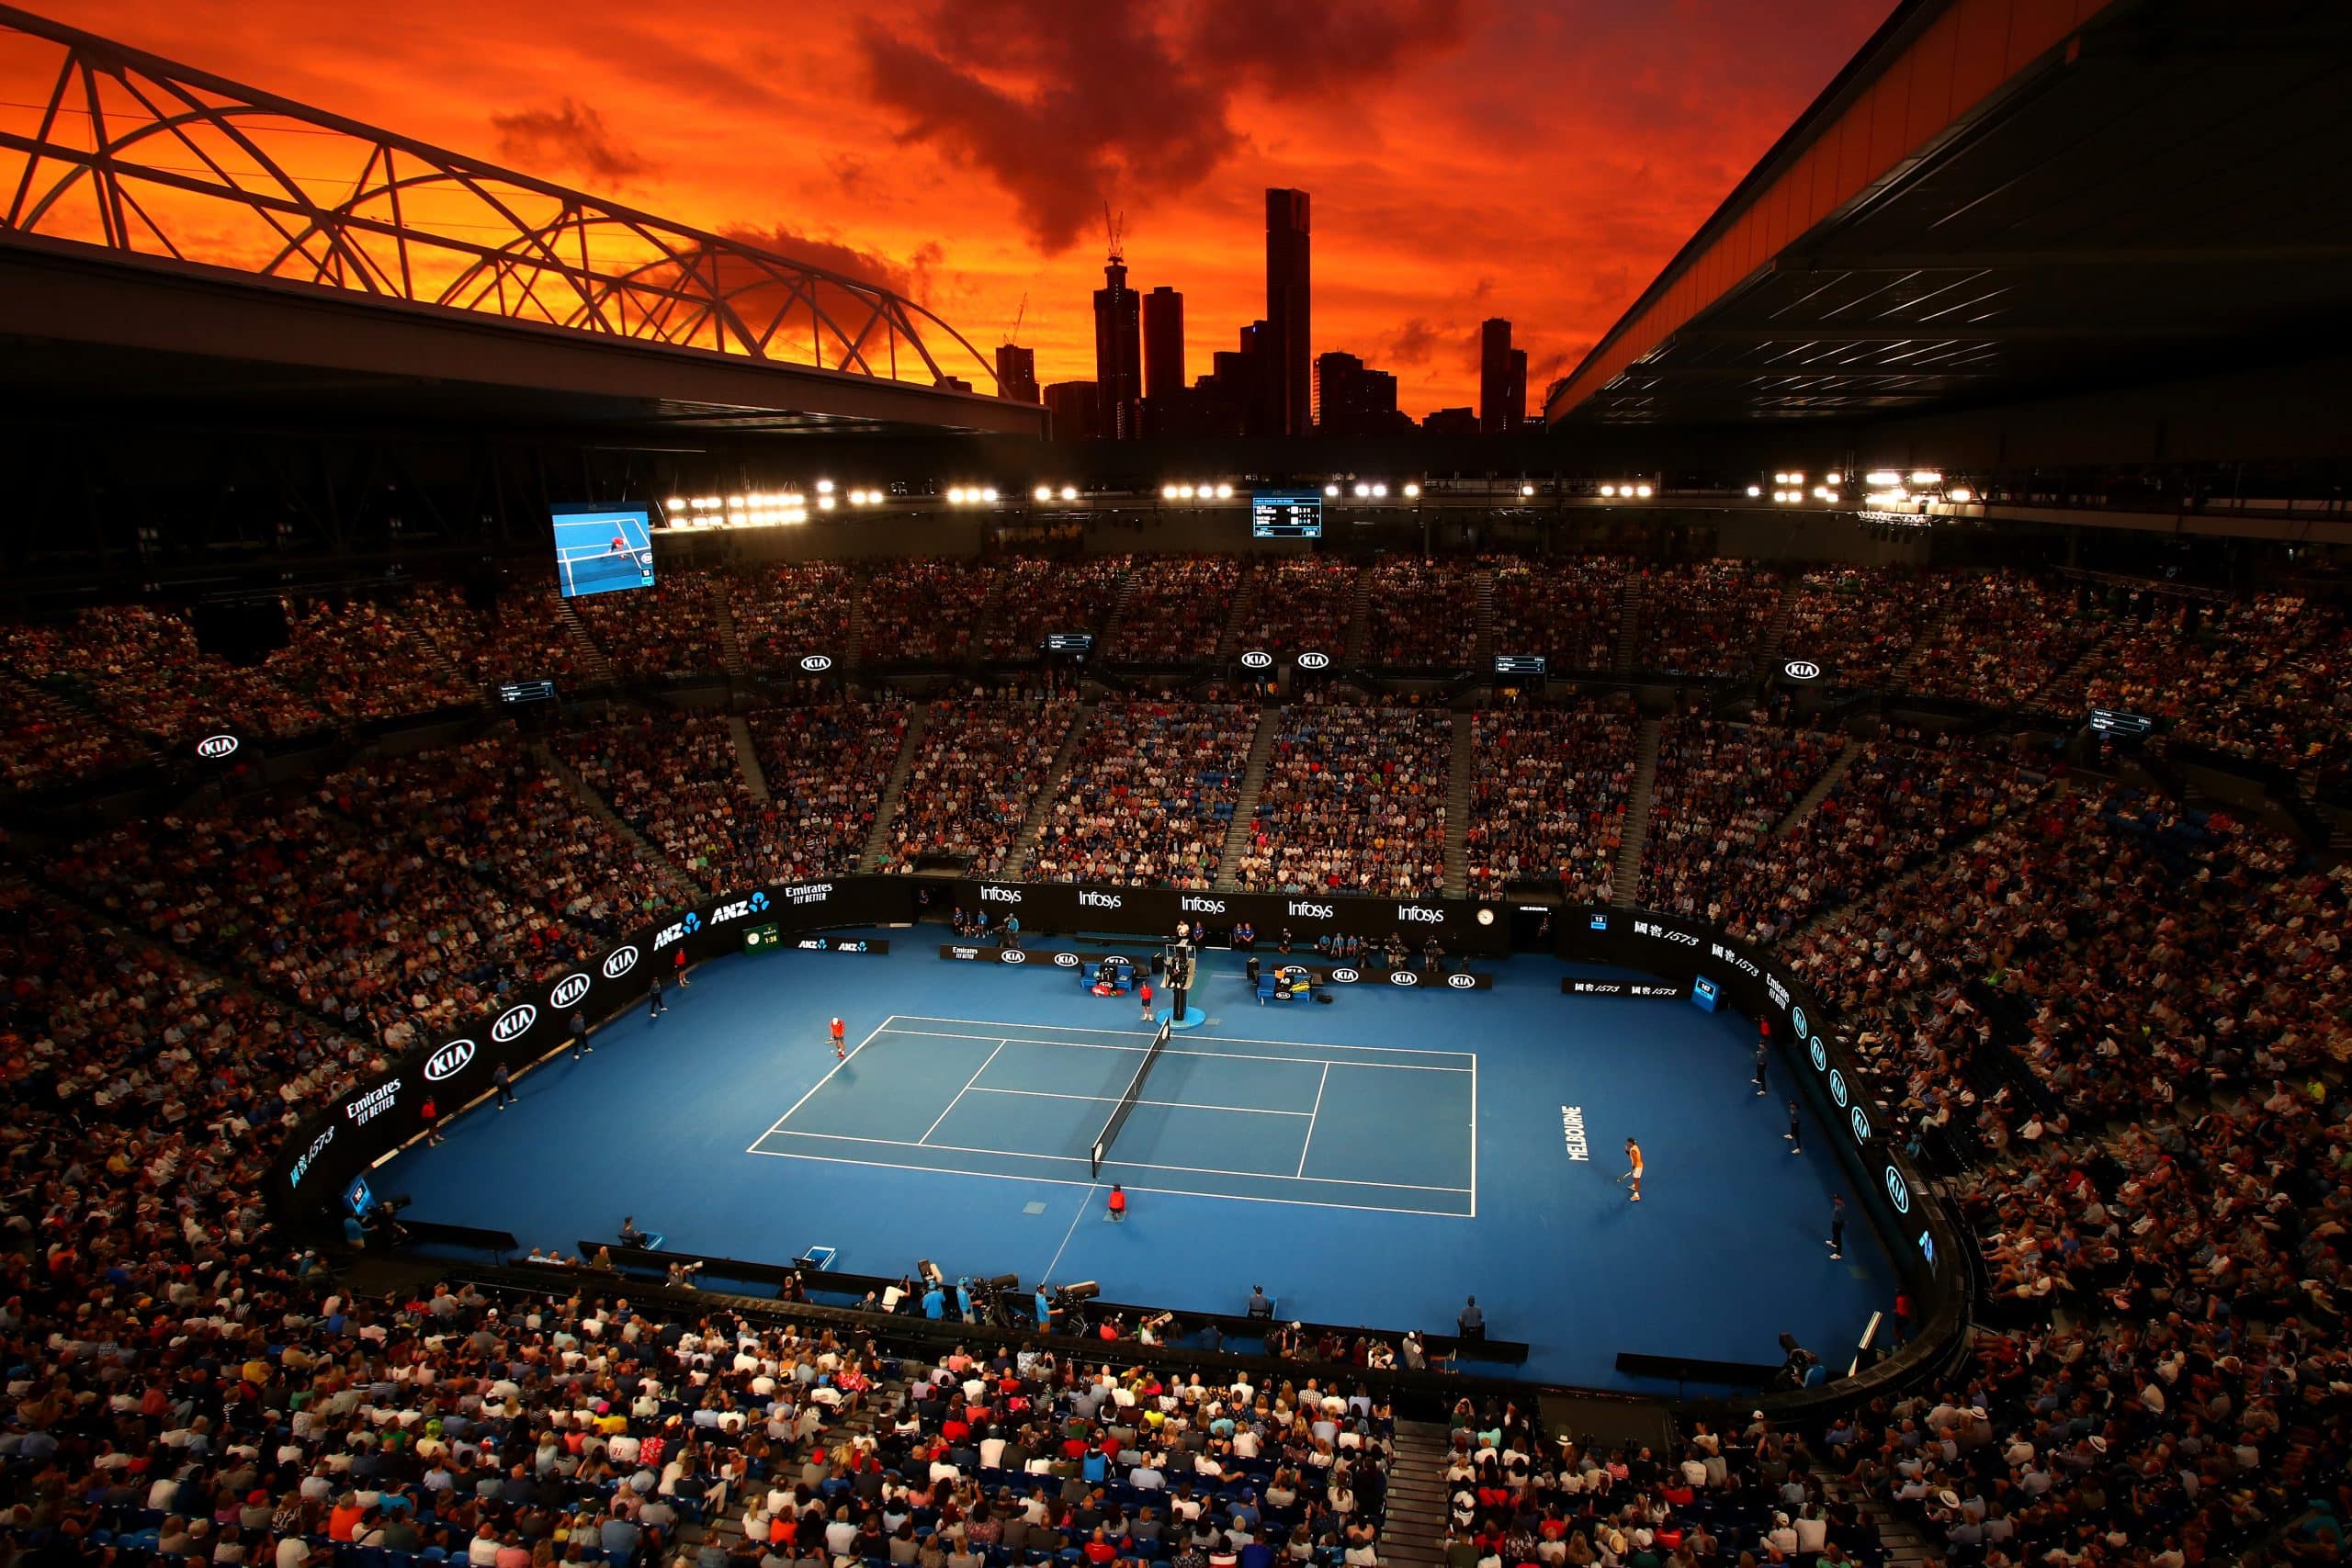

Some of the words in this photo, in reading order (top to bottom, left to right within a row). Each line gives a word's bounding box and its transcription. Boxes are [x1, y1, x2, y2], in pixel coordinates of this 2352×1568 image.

[785, 883, 833, 897] Emirates
[793, 896, 804, 905] FLY
[805, 894, 827, 903] BETTER
[980, 886, 1022, 904] Infosys
[1080, 890, 1122, 909] Infosys
[710, 900, 749, 925] ANZ
[1182, 896, 1226, 915] Infosys
[1289, 900, 1334, 919] Infosys
[1398, 905, 1444, 924] Infosys
[653, 922, 684, 952] ANZ
[797, 940, 818, 949] ANZ
[838, 942, 858, 952] ANZ
[1766, 973, 1790, 1003] Emirates
[346, 1077, 401, 1119] Emirates
[357, 1110, 368, 1126] FLY
[369, 1094, 396, 1118] BETTER
[1561, 1105, 1589, 1161] MELBOURNE
